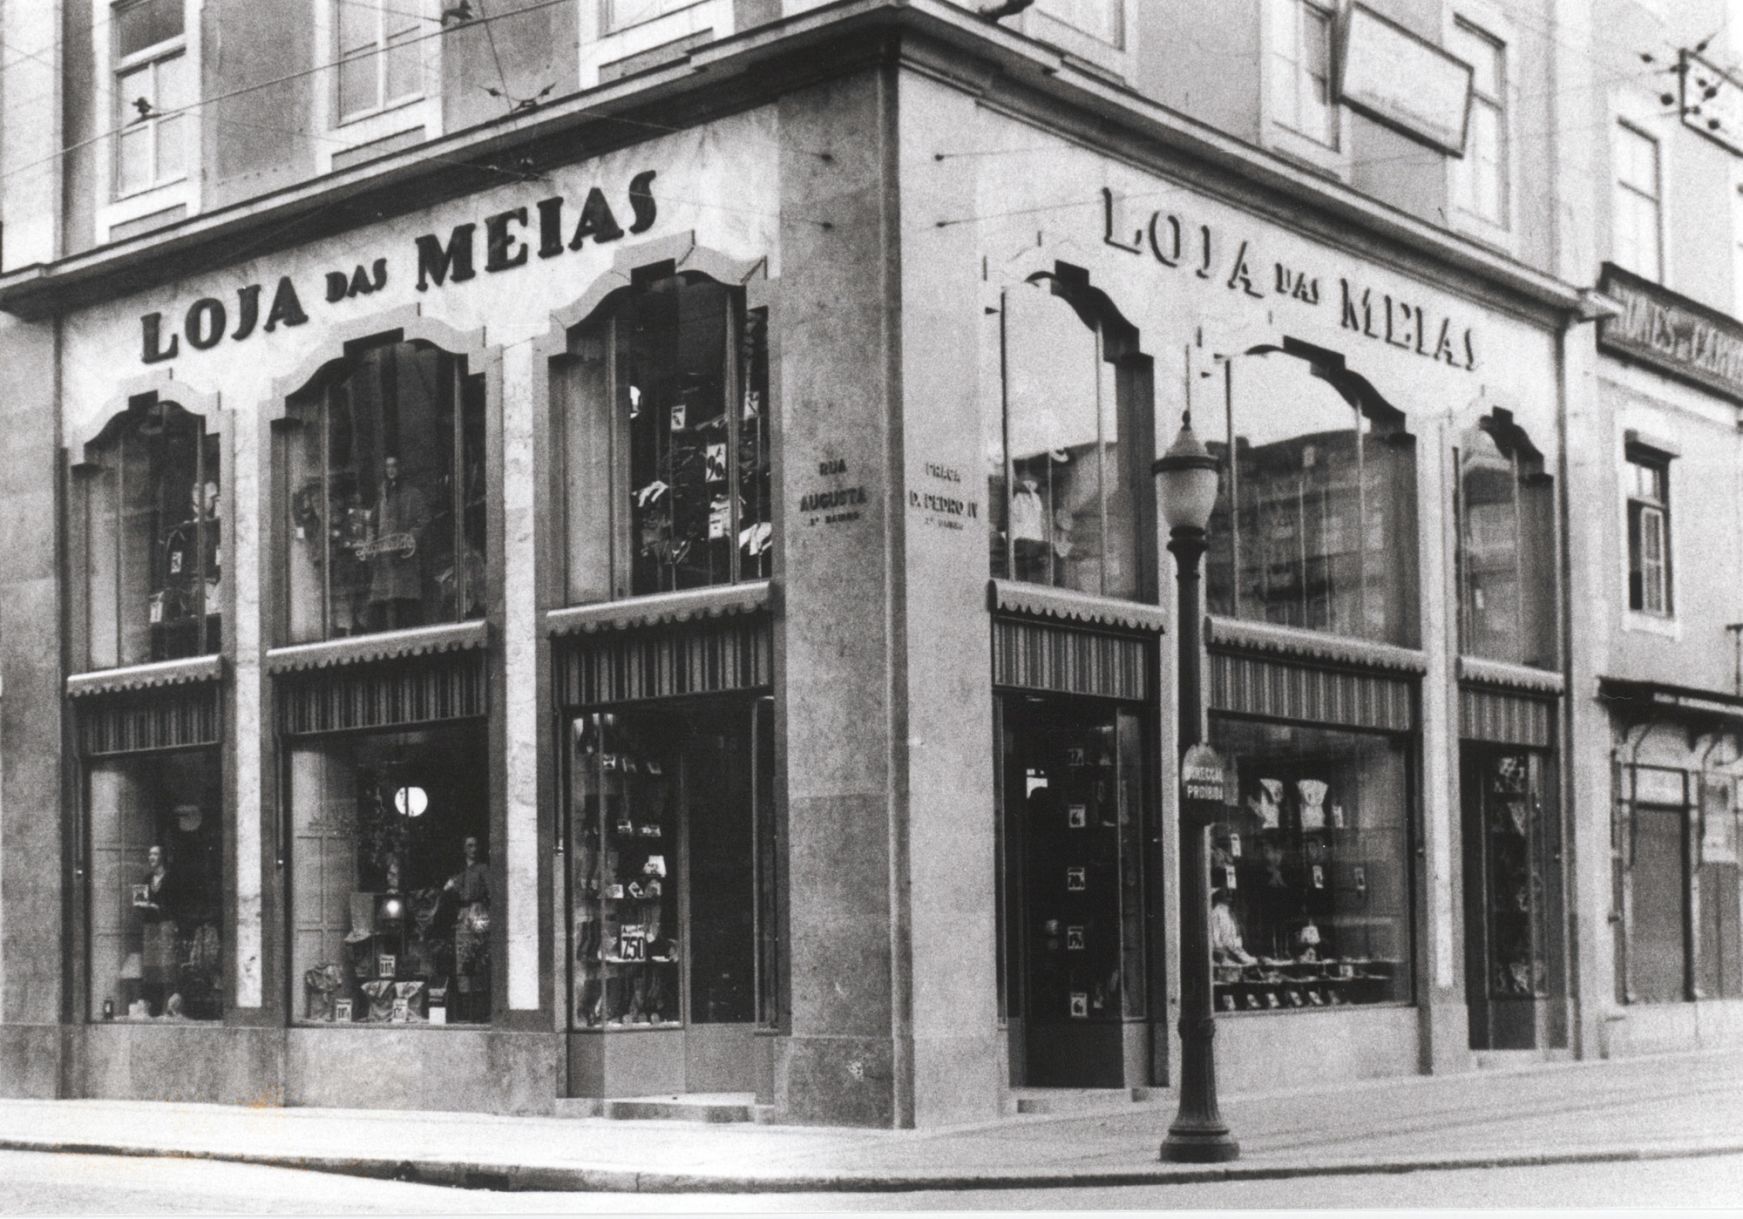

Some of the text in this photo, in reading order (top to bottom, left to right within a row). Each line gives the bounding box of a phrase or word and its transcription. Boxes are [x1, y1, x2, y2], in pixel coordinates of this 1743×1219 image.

[140, 169, 658, 364] LOJA DAS MEIAS
[1101, 186, 1480, 371] LOJA DAS MEIAS
[819, 458, 847, 476] RUA
[800, 486, 867, 512] AUGUSTA
[924, 493, 964, 515] PEDRO
